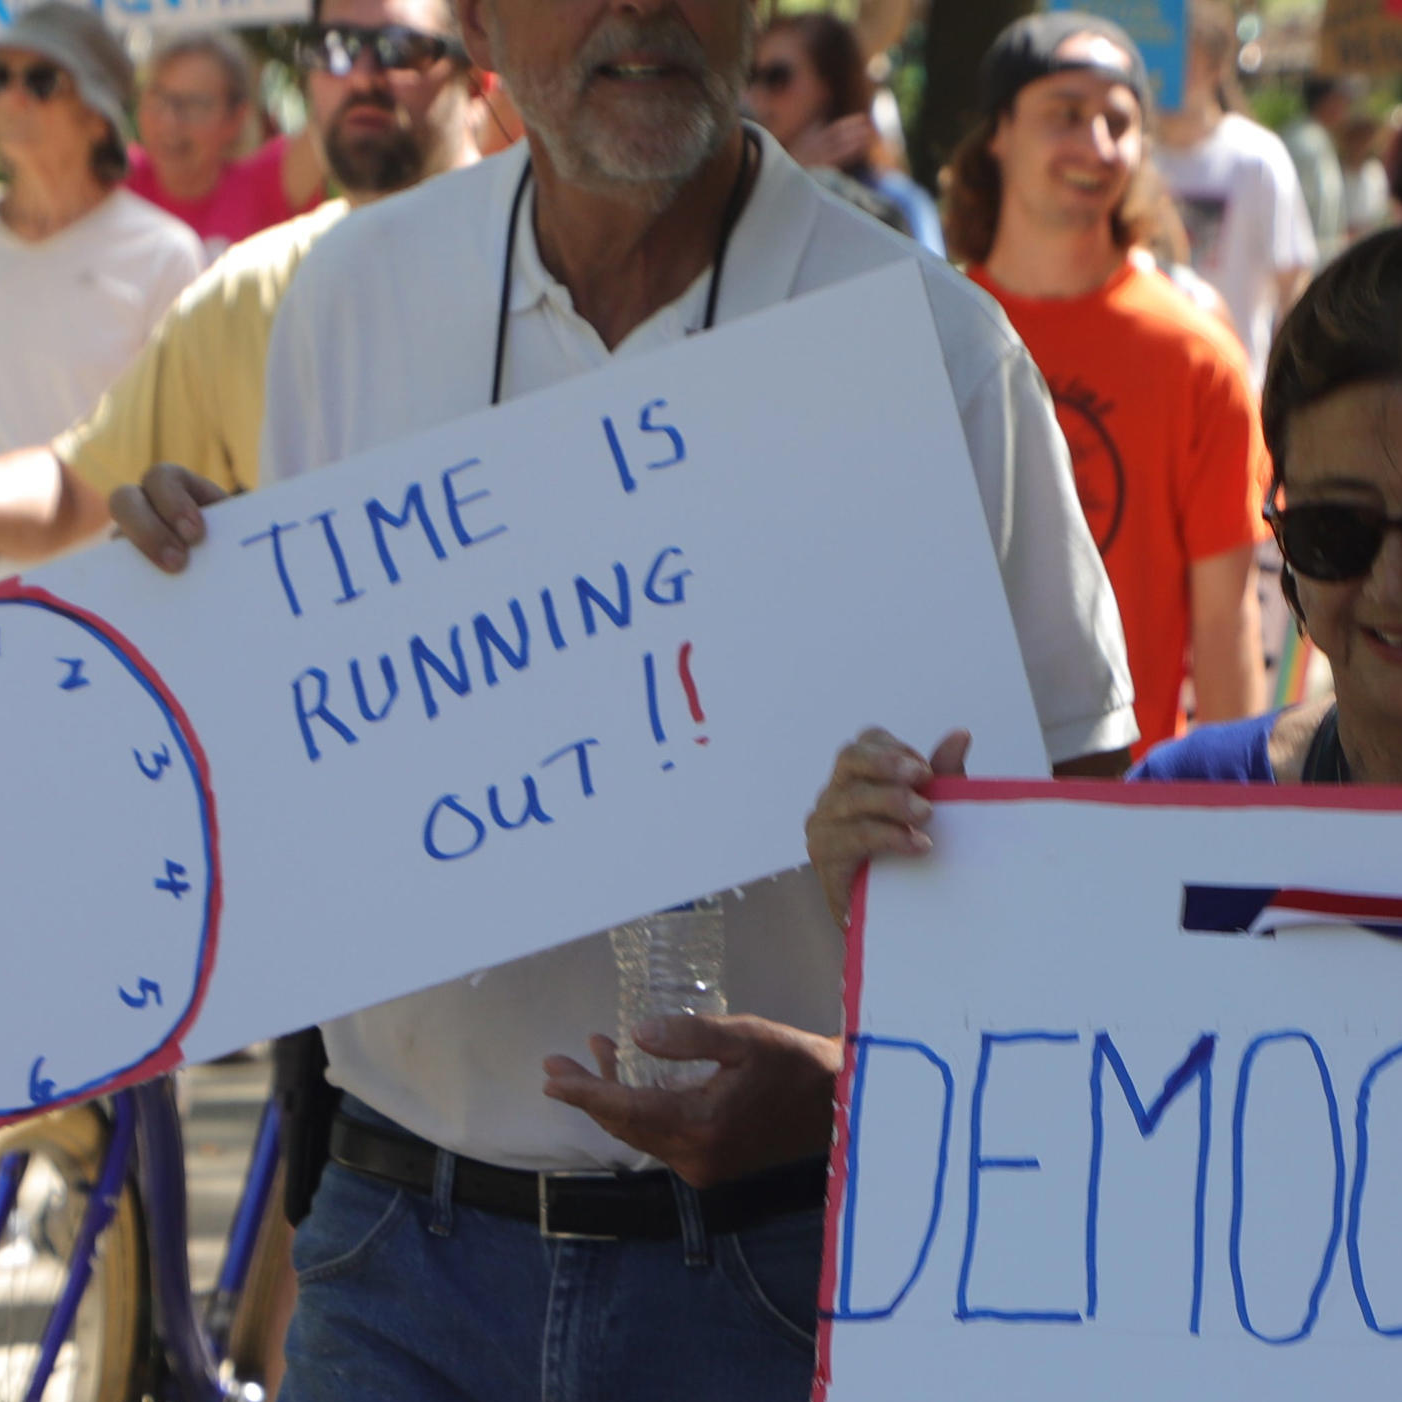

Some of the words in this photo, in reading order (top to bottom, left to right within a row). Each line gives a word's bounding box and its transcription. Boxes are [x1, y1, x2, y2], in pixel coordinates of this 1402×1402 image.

[240, 456, 509, 618] TIME
[600, 398, 688, 494] IS
[55, 655, 91, 692] 2
[291, 546, 693, 762] RUNNING
[132, 742, 173, 782] 3
[153, 858, 191, 900] 4
[117, 975, 164, 1009] 5
[27, 1055, 59, 1106] 6
